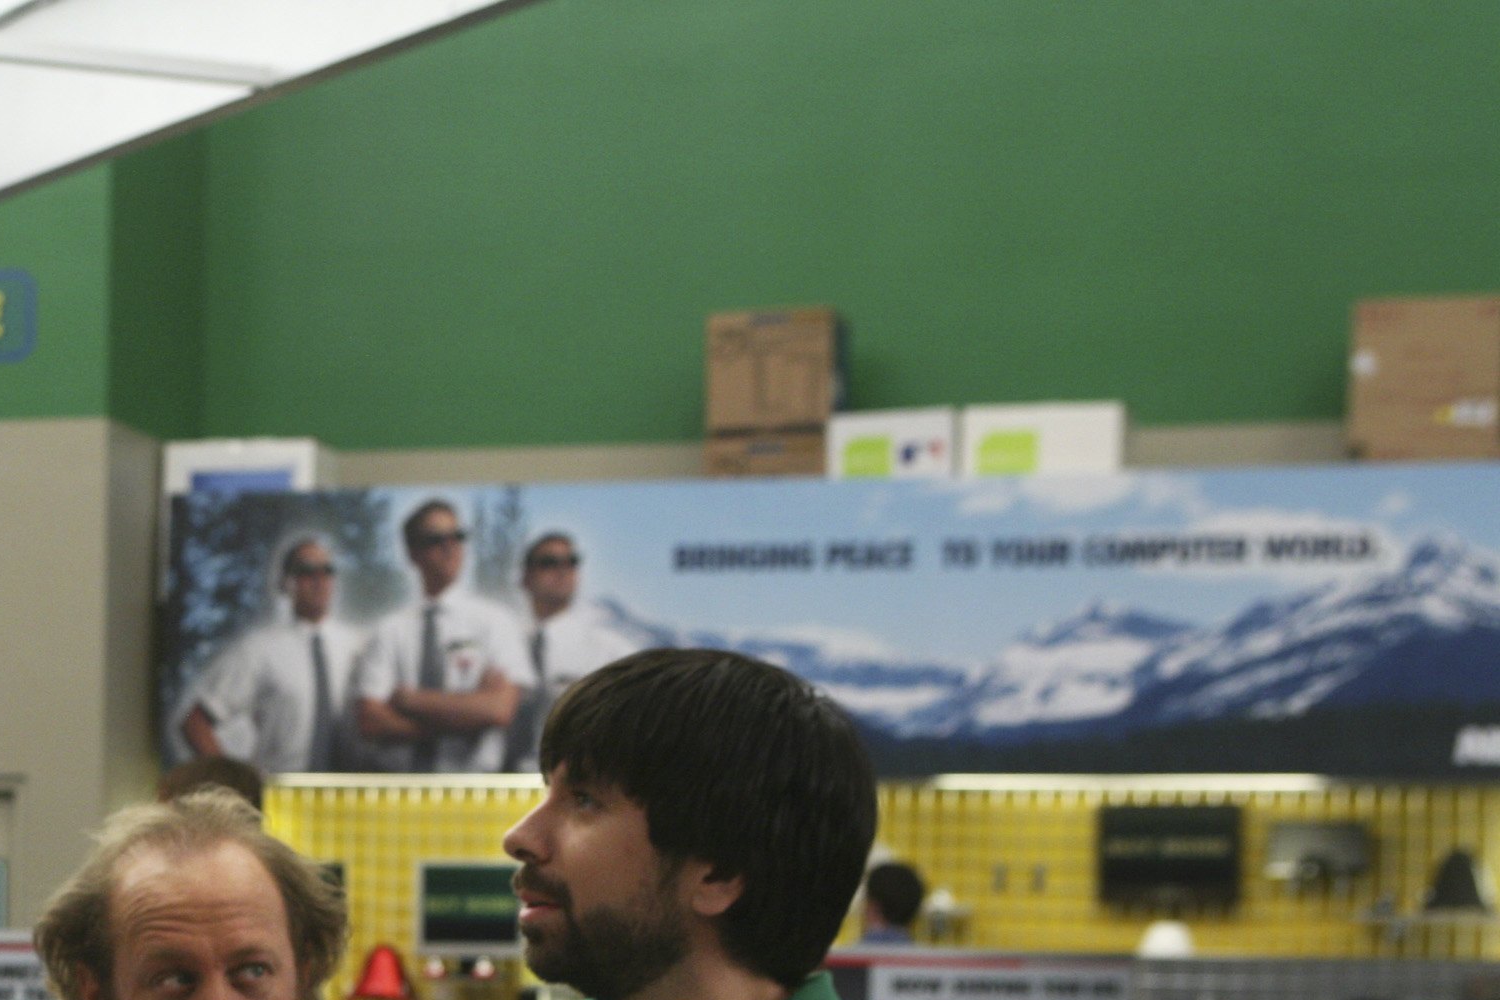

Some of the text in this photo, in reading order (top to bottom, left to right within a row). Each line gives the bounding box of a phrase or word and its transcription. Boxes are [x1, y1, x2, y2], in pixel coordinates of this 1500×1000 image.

[673, 543, 813, 571] BRINGING
[825, 540, 913, 569] PEACE
[942, 538, 981, 567] TO
[992, 536, 1072, 566] YOUR
[1082, 534, 1247, 565] COMPUTER
